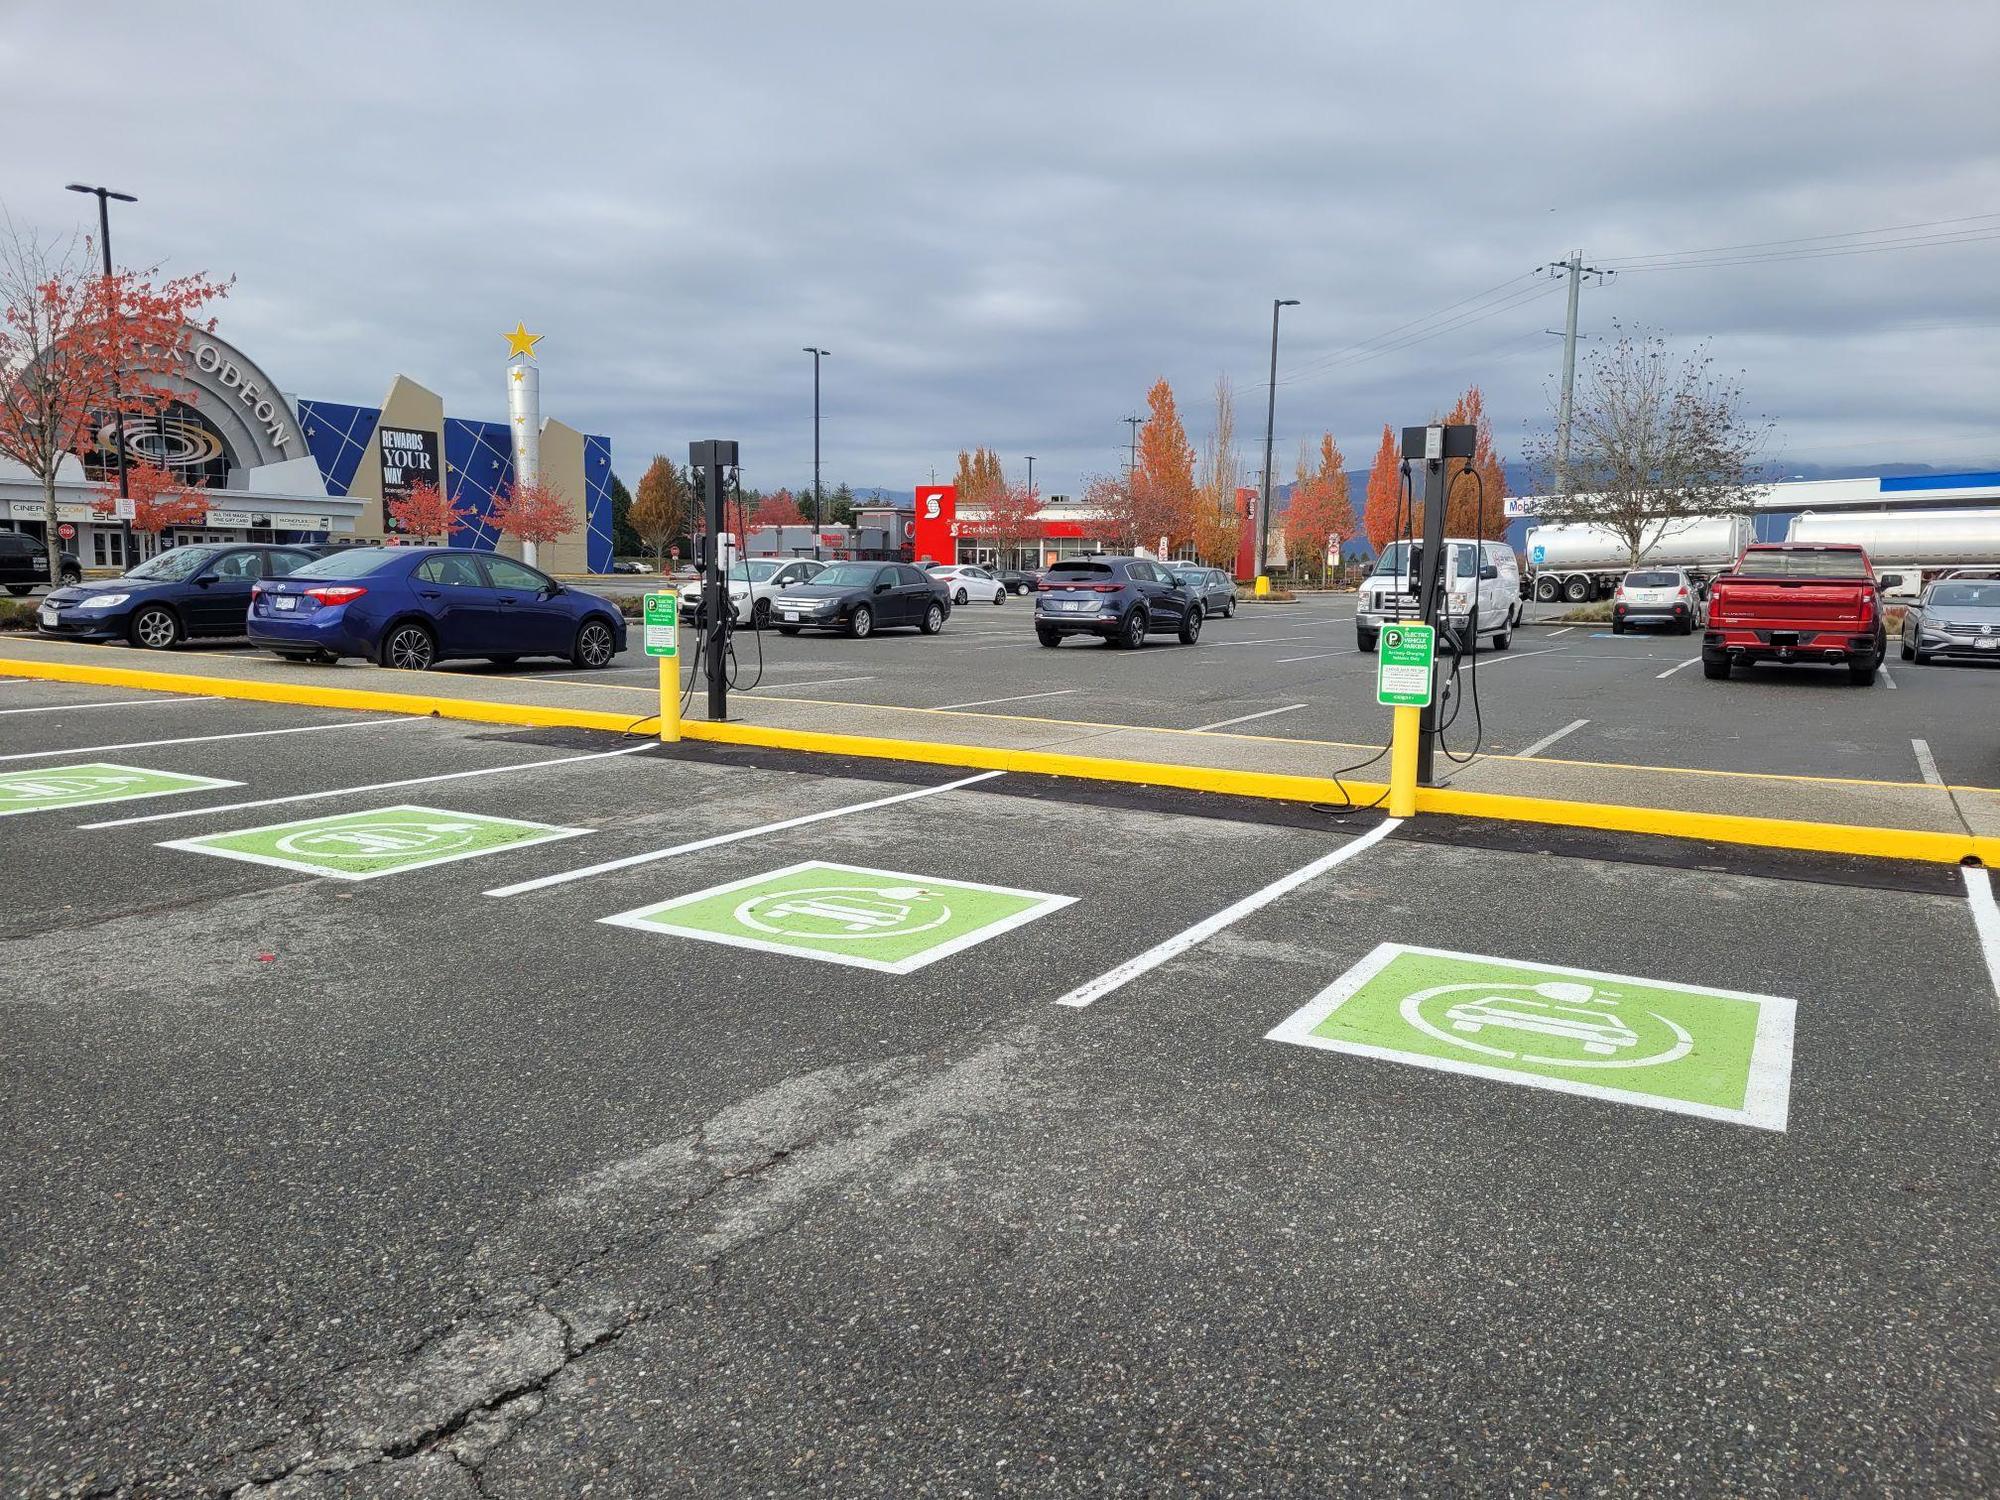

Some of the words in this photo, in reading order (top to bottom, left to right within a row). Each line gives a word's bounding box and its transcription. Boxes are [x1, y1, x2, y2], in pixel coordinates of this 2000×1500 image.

[194, 343, 291, 448] ODEON
[381, 430, 424, 451] REWARDS
[384, 449, 432, 470] YOUR
[384, 467, 404, 485] WAY.
[59, 528, 75, 536] STOP
[962, 523, 1017, 534] Scotiabk
[1389, 632, 1399, 645] P
